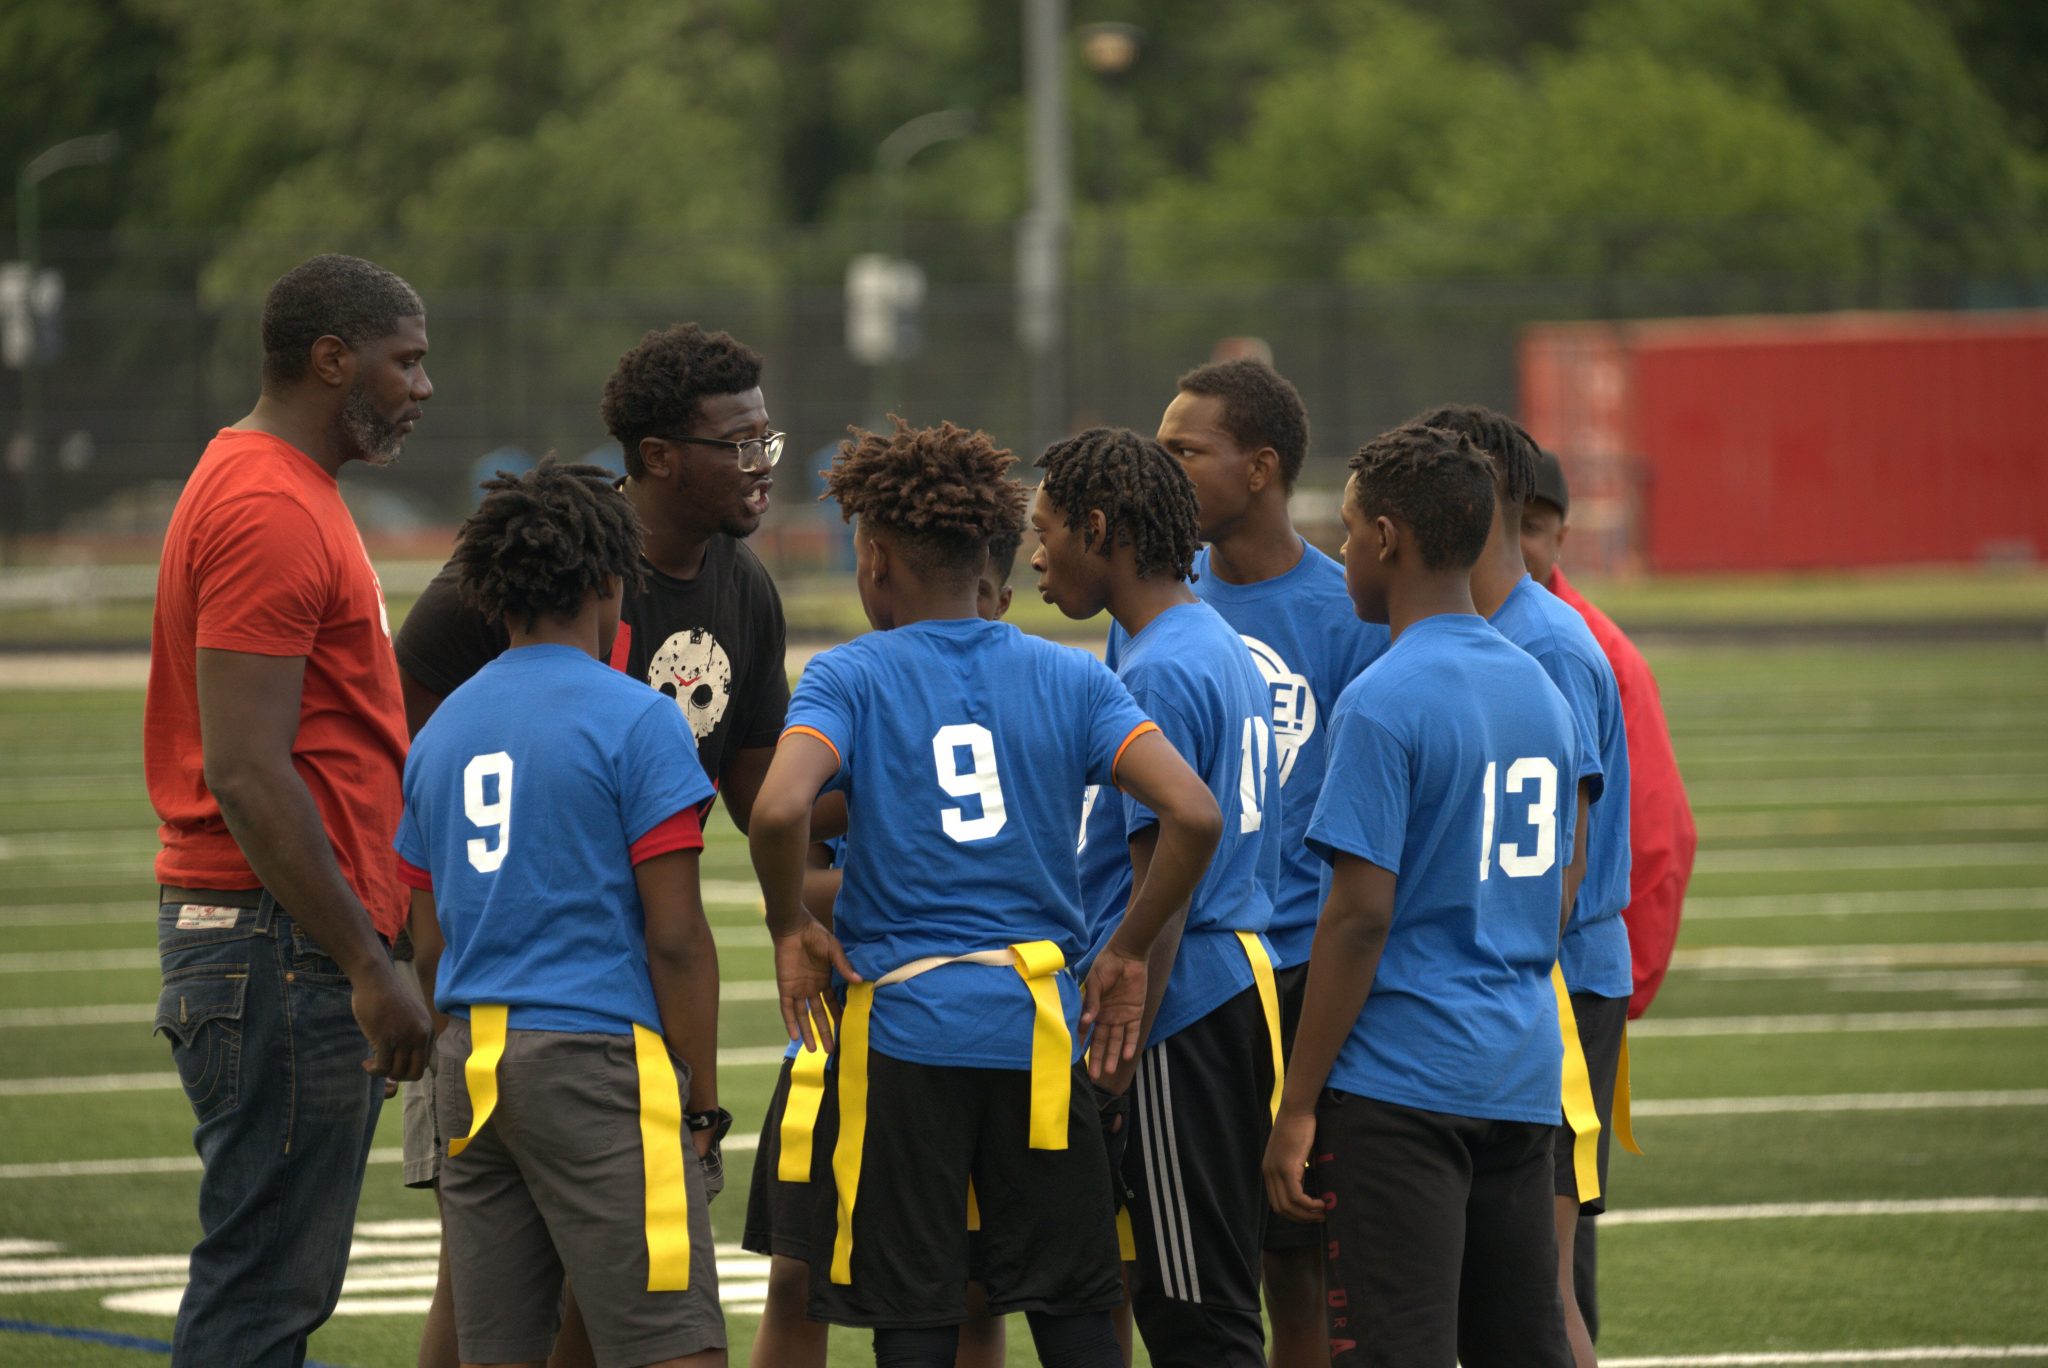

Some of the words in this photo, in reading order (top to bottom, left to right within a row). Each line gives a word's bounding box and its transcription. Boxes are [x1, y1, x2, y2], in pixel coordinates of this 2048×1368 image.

[463, 750, 514, 875] 9
[932, 722, 1008, 844] 9
[1480, 757, 1558, 881] 13
